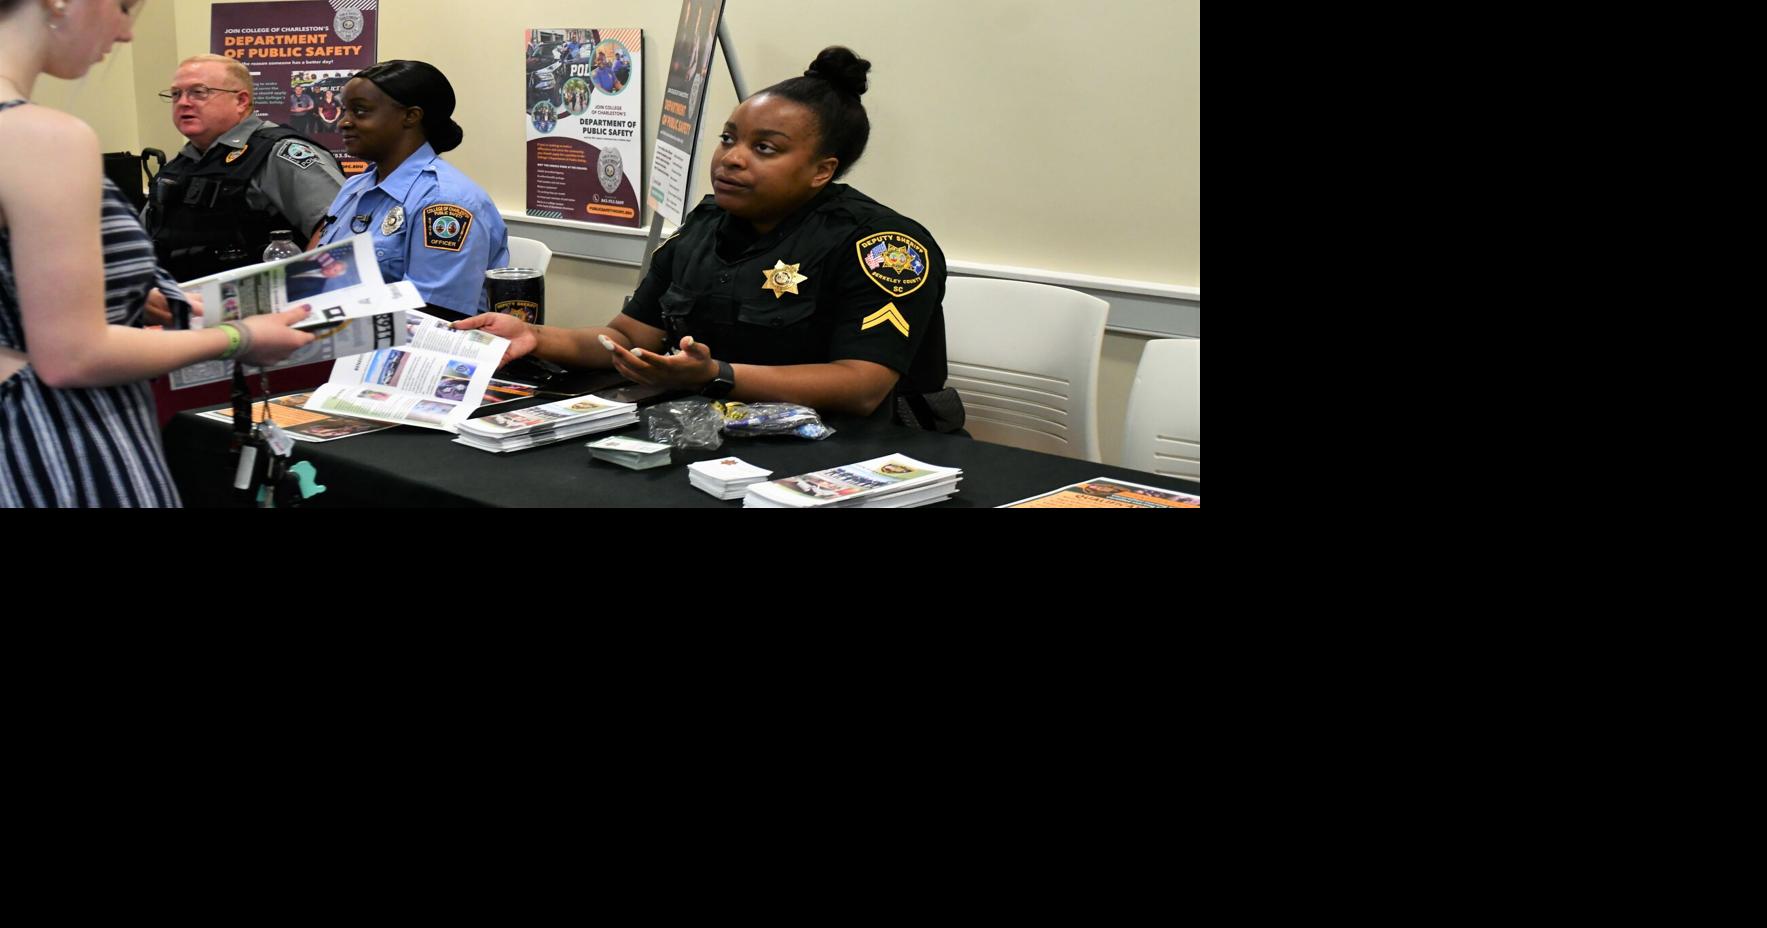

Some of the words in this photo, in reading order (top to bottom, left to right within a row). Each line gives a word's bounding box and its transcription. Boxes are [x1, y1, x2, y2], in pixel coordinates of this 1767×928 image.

[224, 34, 328, 46] DEPARTMENT
[224, 50, 245, 58] OF
[248, 47, 302, 58] PUBLIC
[306, 46, 362, 57] SAFETY
[580, 119, 626, 128] DEPARTMENT
[627, 121, 636, 129] OF
[582, 127, 606, 135] PUBLIC
[608, 128, 634, 137] SAFETY
[861, 235, 893, 248] DEPUTY
[896, 236, 924, 253] SHERIFF
[872, 271, 901, 284] BERKELEY
